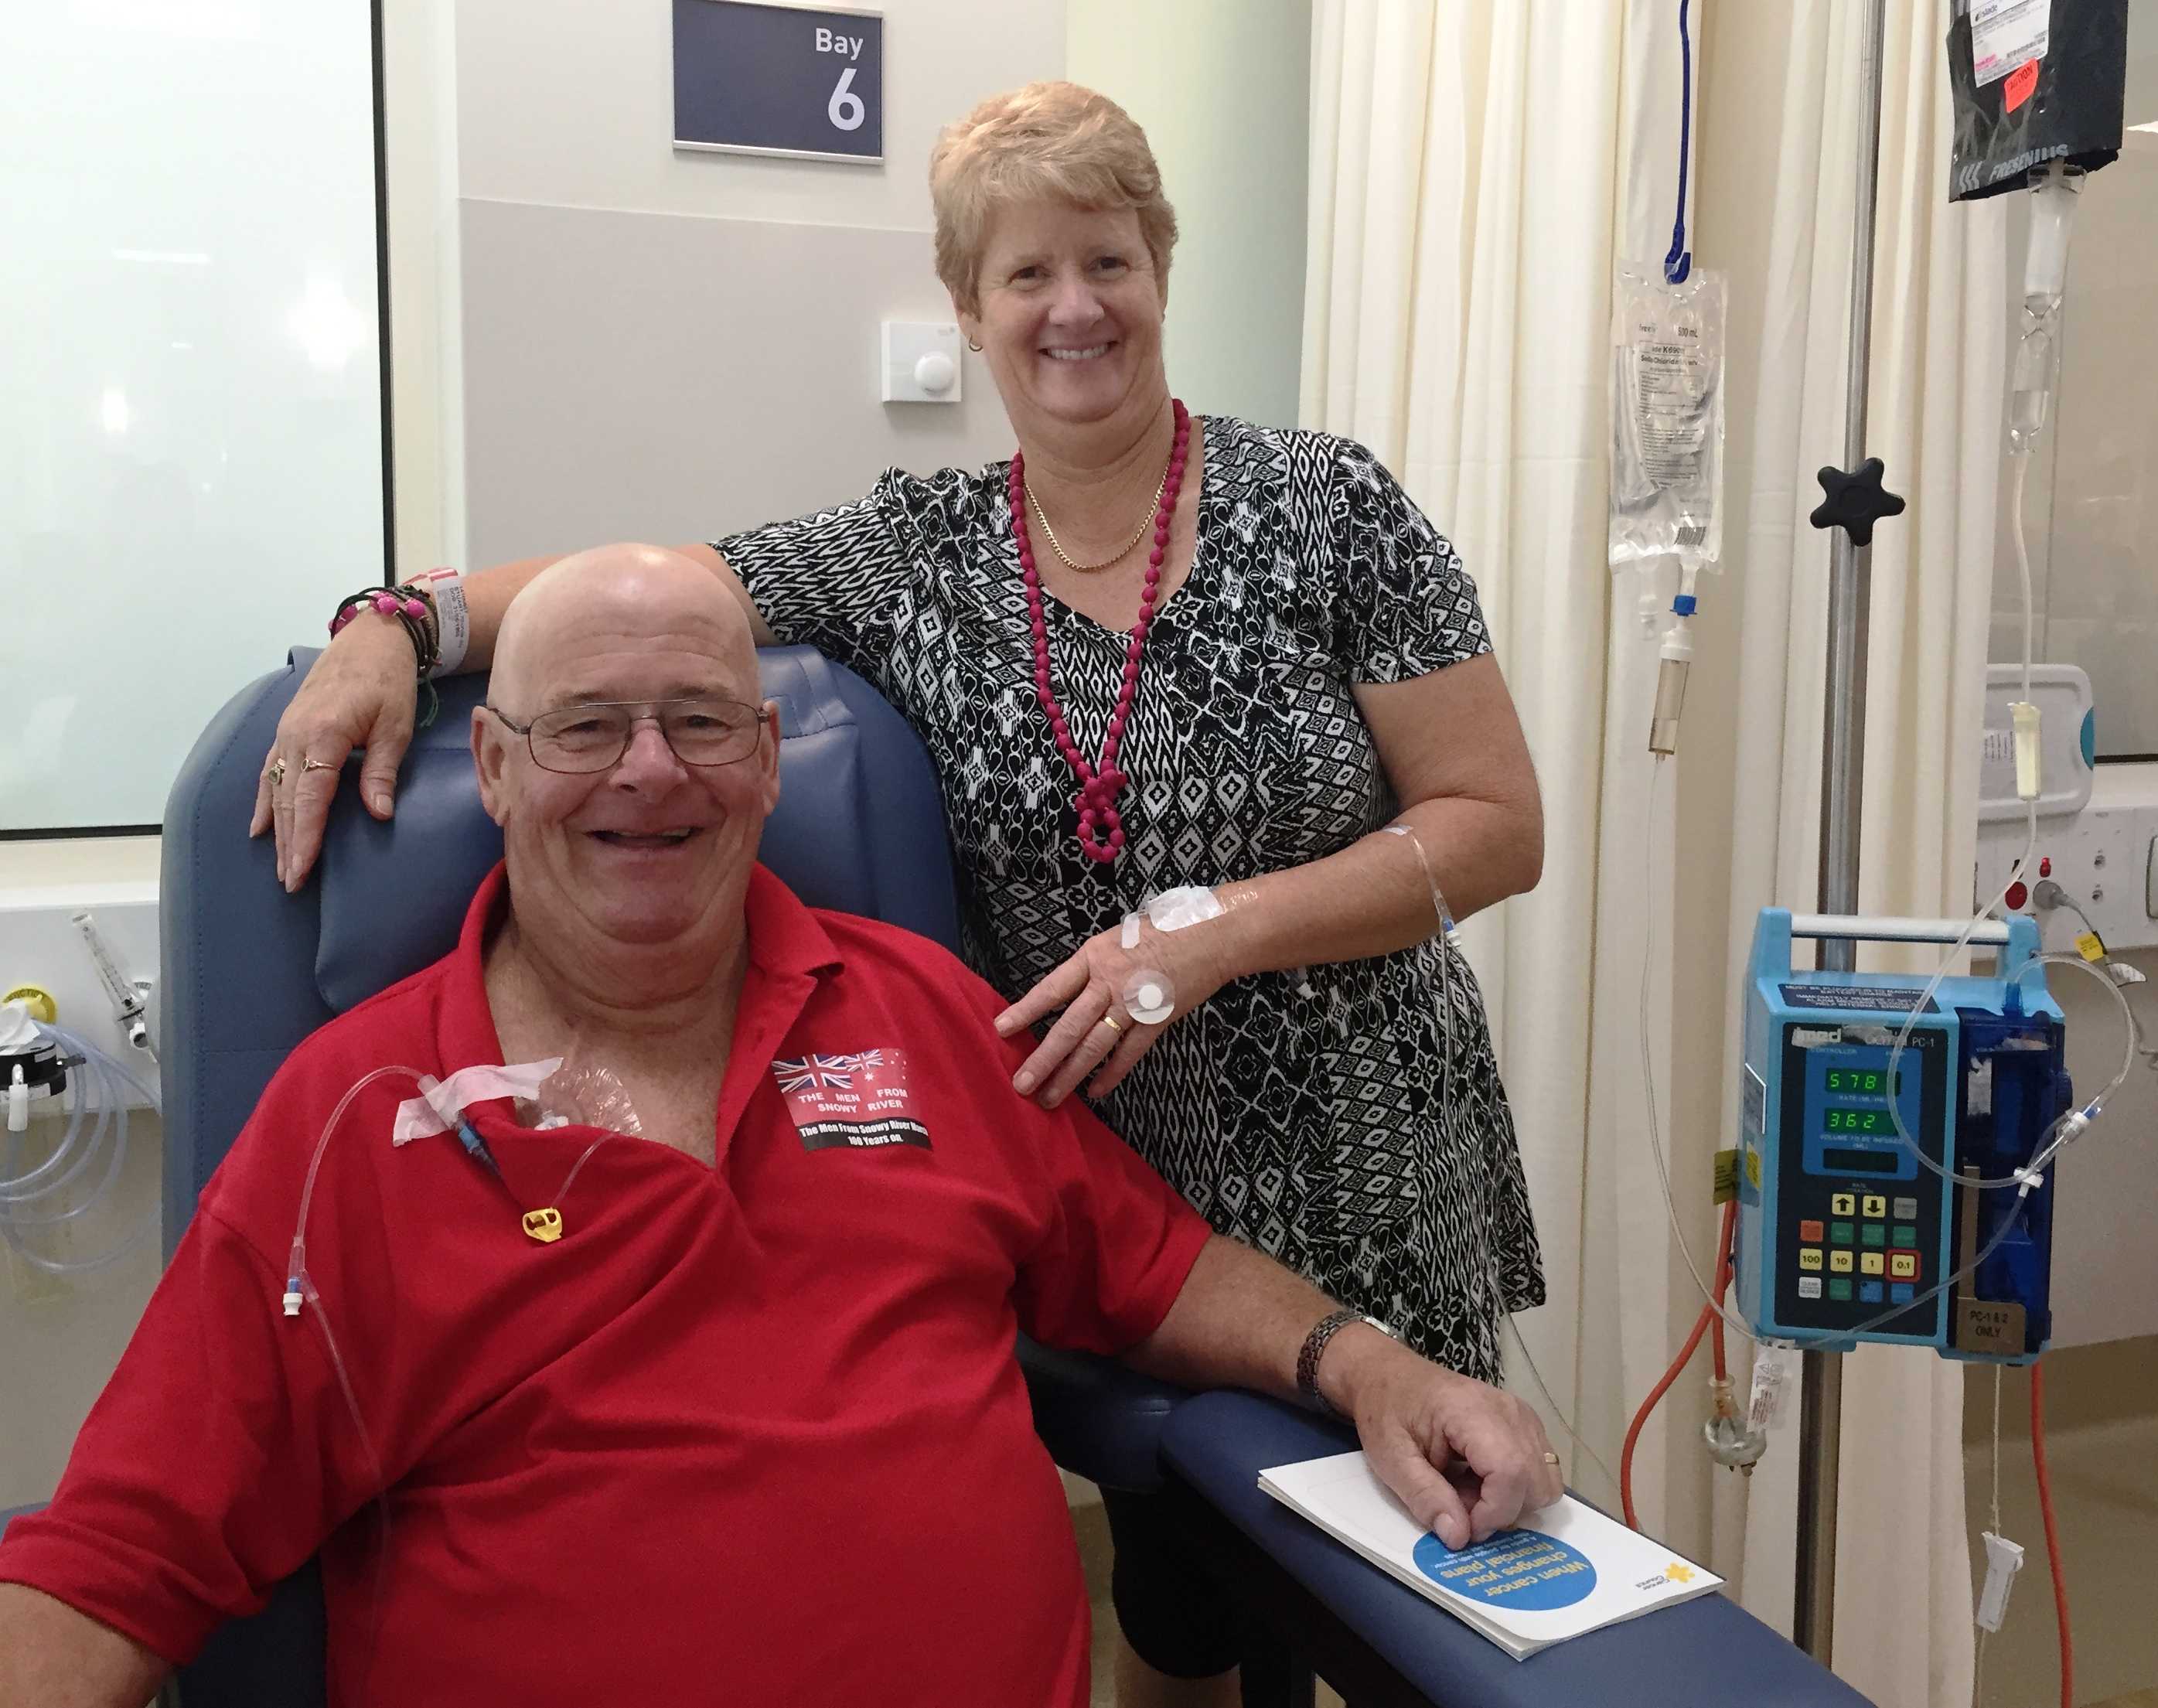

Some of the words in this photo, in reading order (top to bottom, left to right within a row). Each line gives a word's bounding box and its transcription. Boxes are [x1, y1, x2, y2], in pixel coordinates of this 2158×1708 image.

[816, 28, 864, 60] Bay
[828, 67, 865, 131] 6
[1830, 1073, 1877, 1089] 578
[798, 1093, 824, 1103] THE
[836, 1093, 861, 1103] MEN
[877, 1089, 908, 1098] FROM
[817, 1103, 857, 1113] SNOWY
[868, 1099, 903, 1111] RIVER
[799, 1127, 819, 1137] The
[819, 1123, 838, 1133] Men
[838, 1123, 860, 1134] From
[859, 1122, 889, 1134] Snowy
[888, 1120, 911, 1130] River
[1830, 1113, 1876, 1128] 362
[864, 1134, 889, 1146] Years
[1803, 1255, 1820, 1263] 100
[1897, 1261, 1911, 1270] 0.1
[1976, 1325, 2002, 1337] ONLY
[1485, 1542, 1555, 1568] financial
[1502, 1551, 1568, 1576] changes
[1440, 1560, 1486, 1579] plans
[1538, 1561, 1589, 1580] When
[1466, 1570, 1503, 1587] your
[1485, 1576, 1539, 1597] cancer
